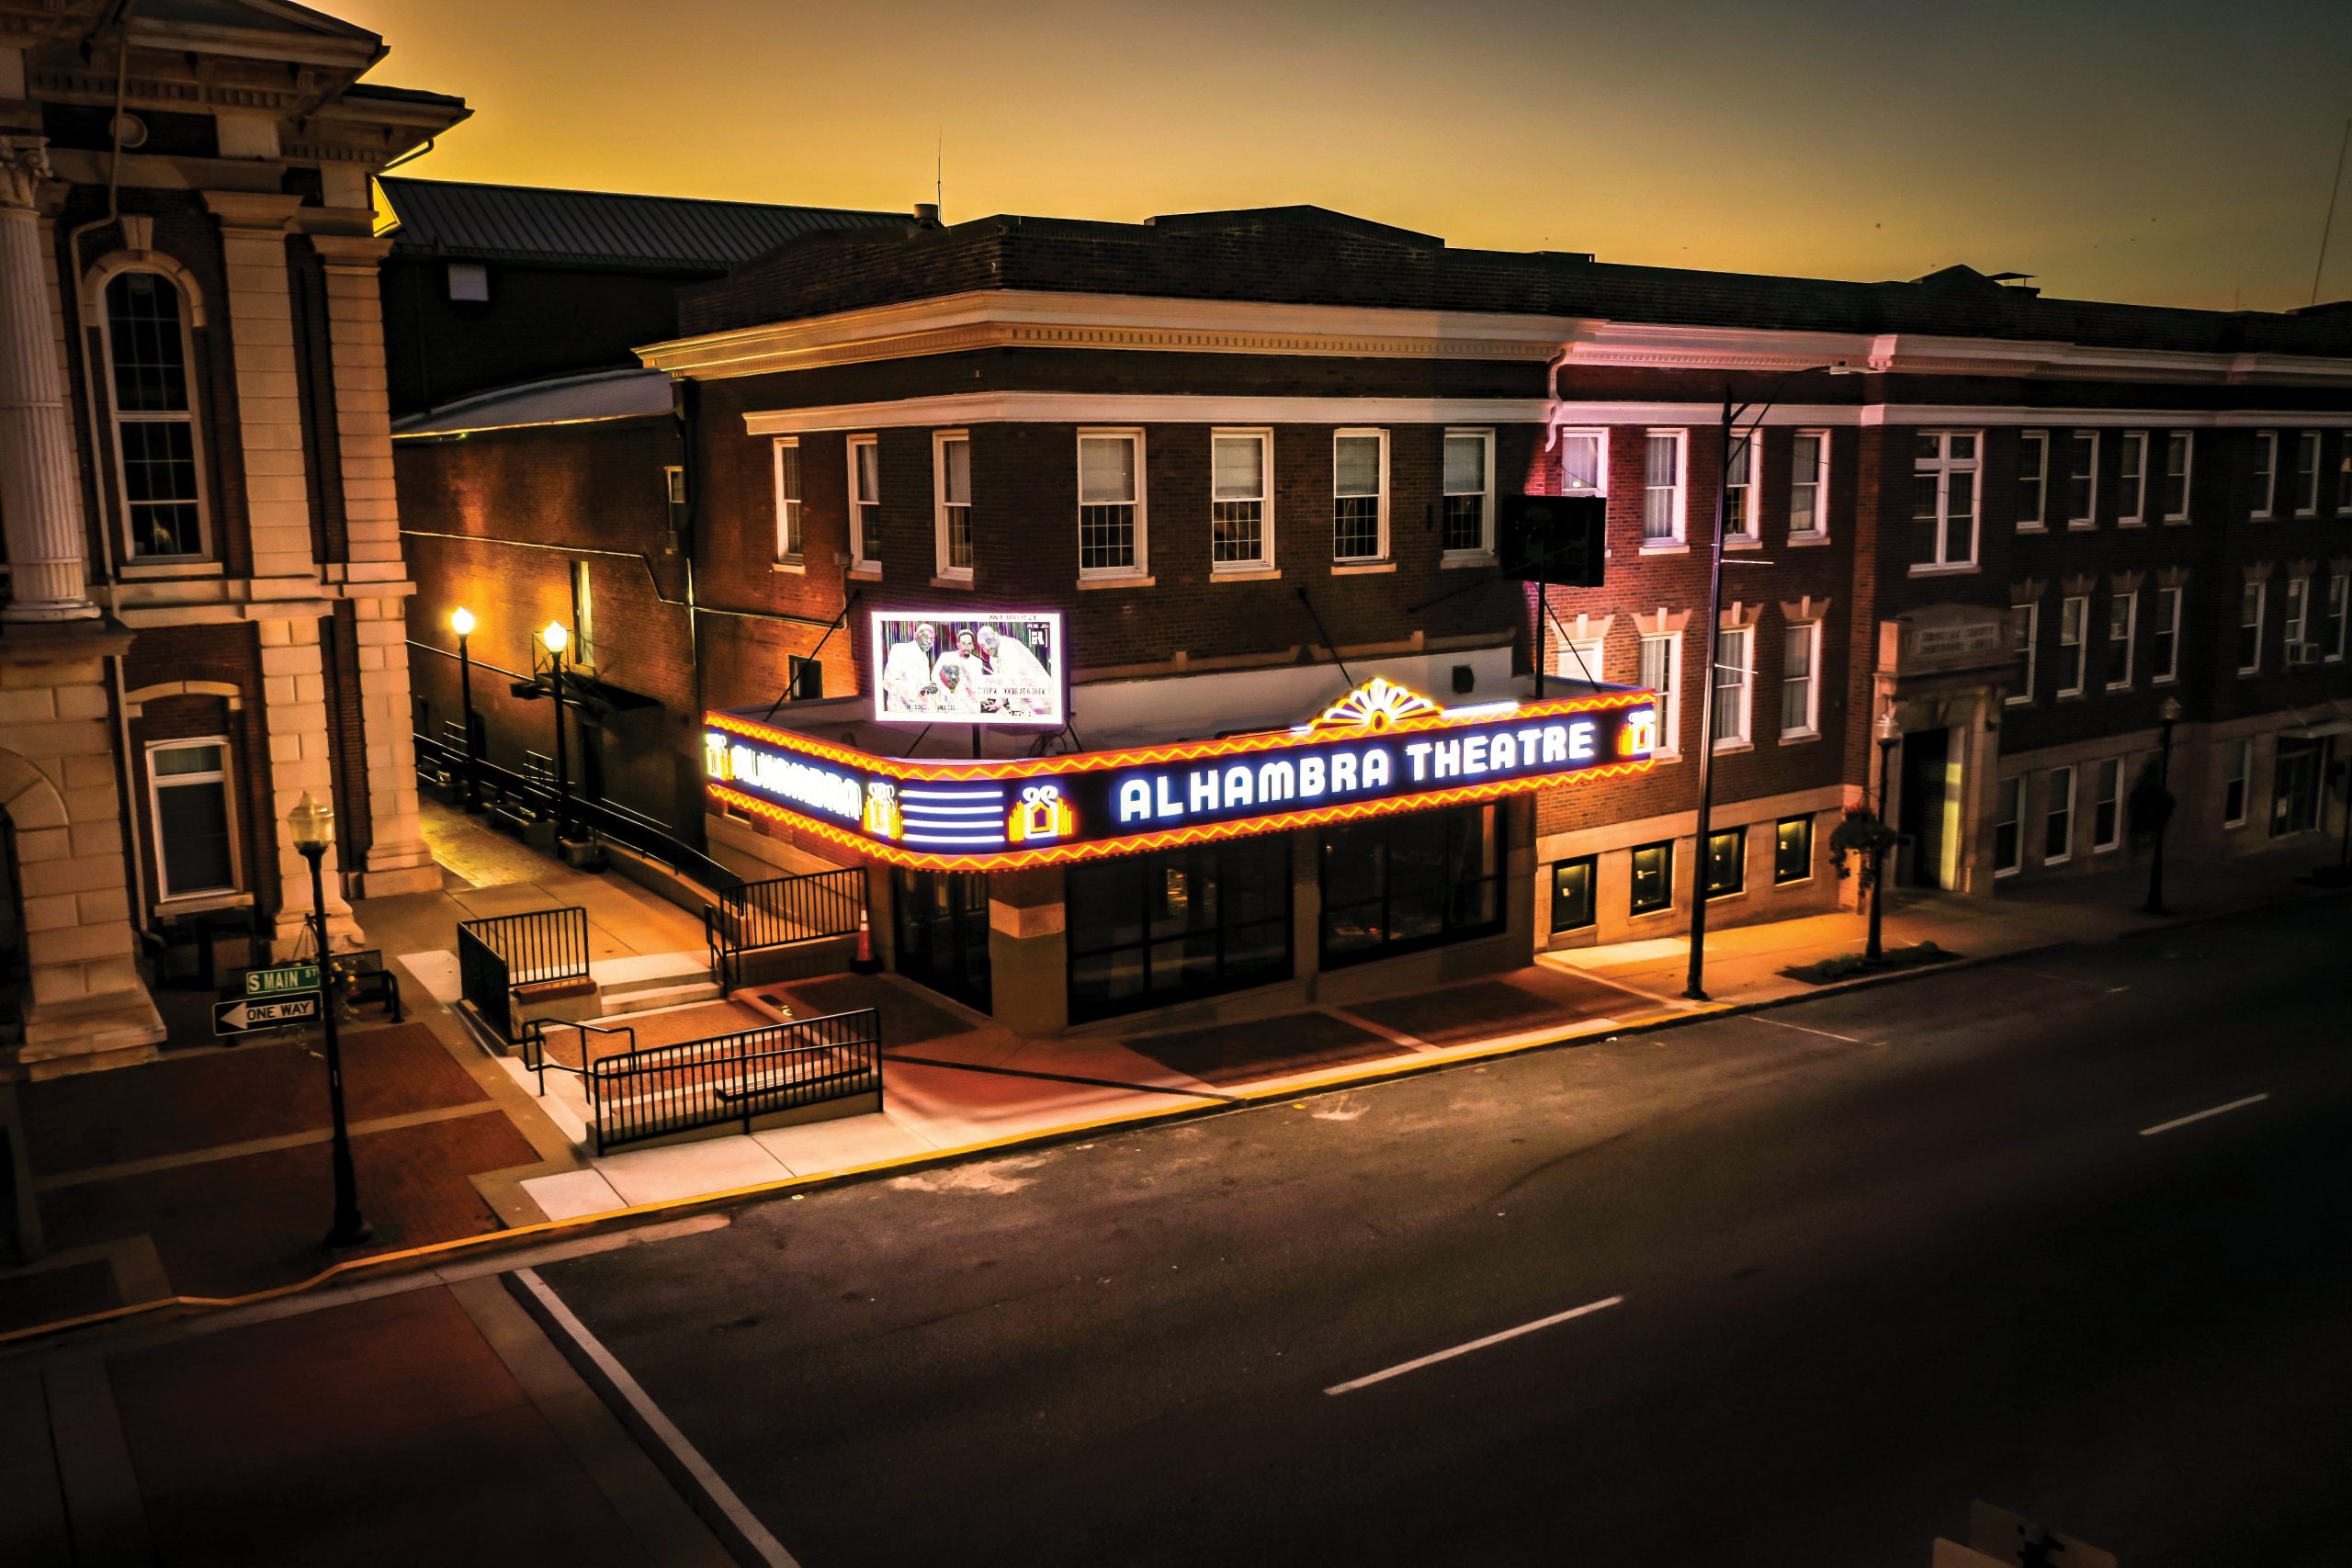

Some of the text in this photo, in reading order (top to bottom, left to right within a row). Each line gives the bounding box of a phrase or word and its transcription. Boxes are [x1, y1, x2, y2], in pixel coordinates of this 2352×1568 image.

[1119, 721, 1595, 822] ALHAMBRA THEATRE
[249, 967, 318, 991] S MAIN ST
[247, 1001, 310, 1021] ONE WAY
